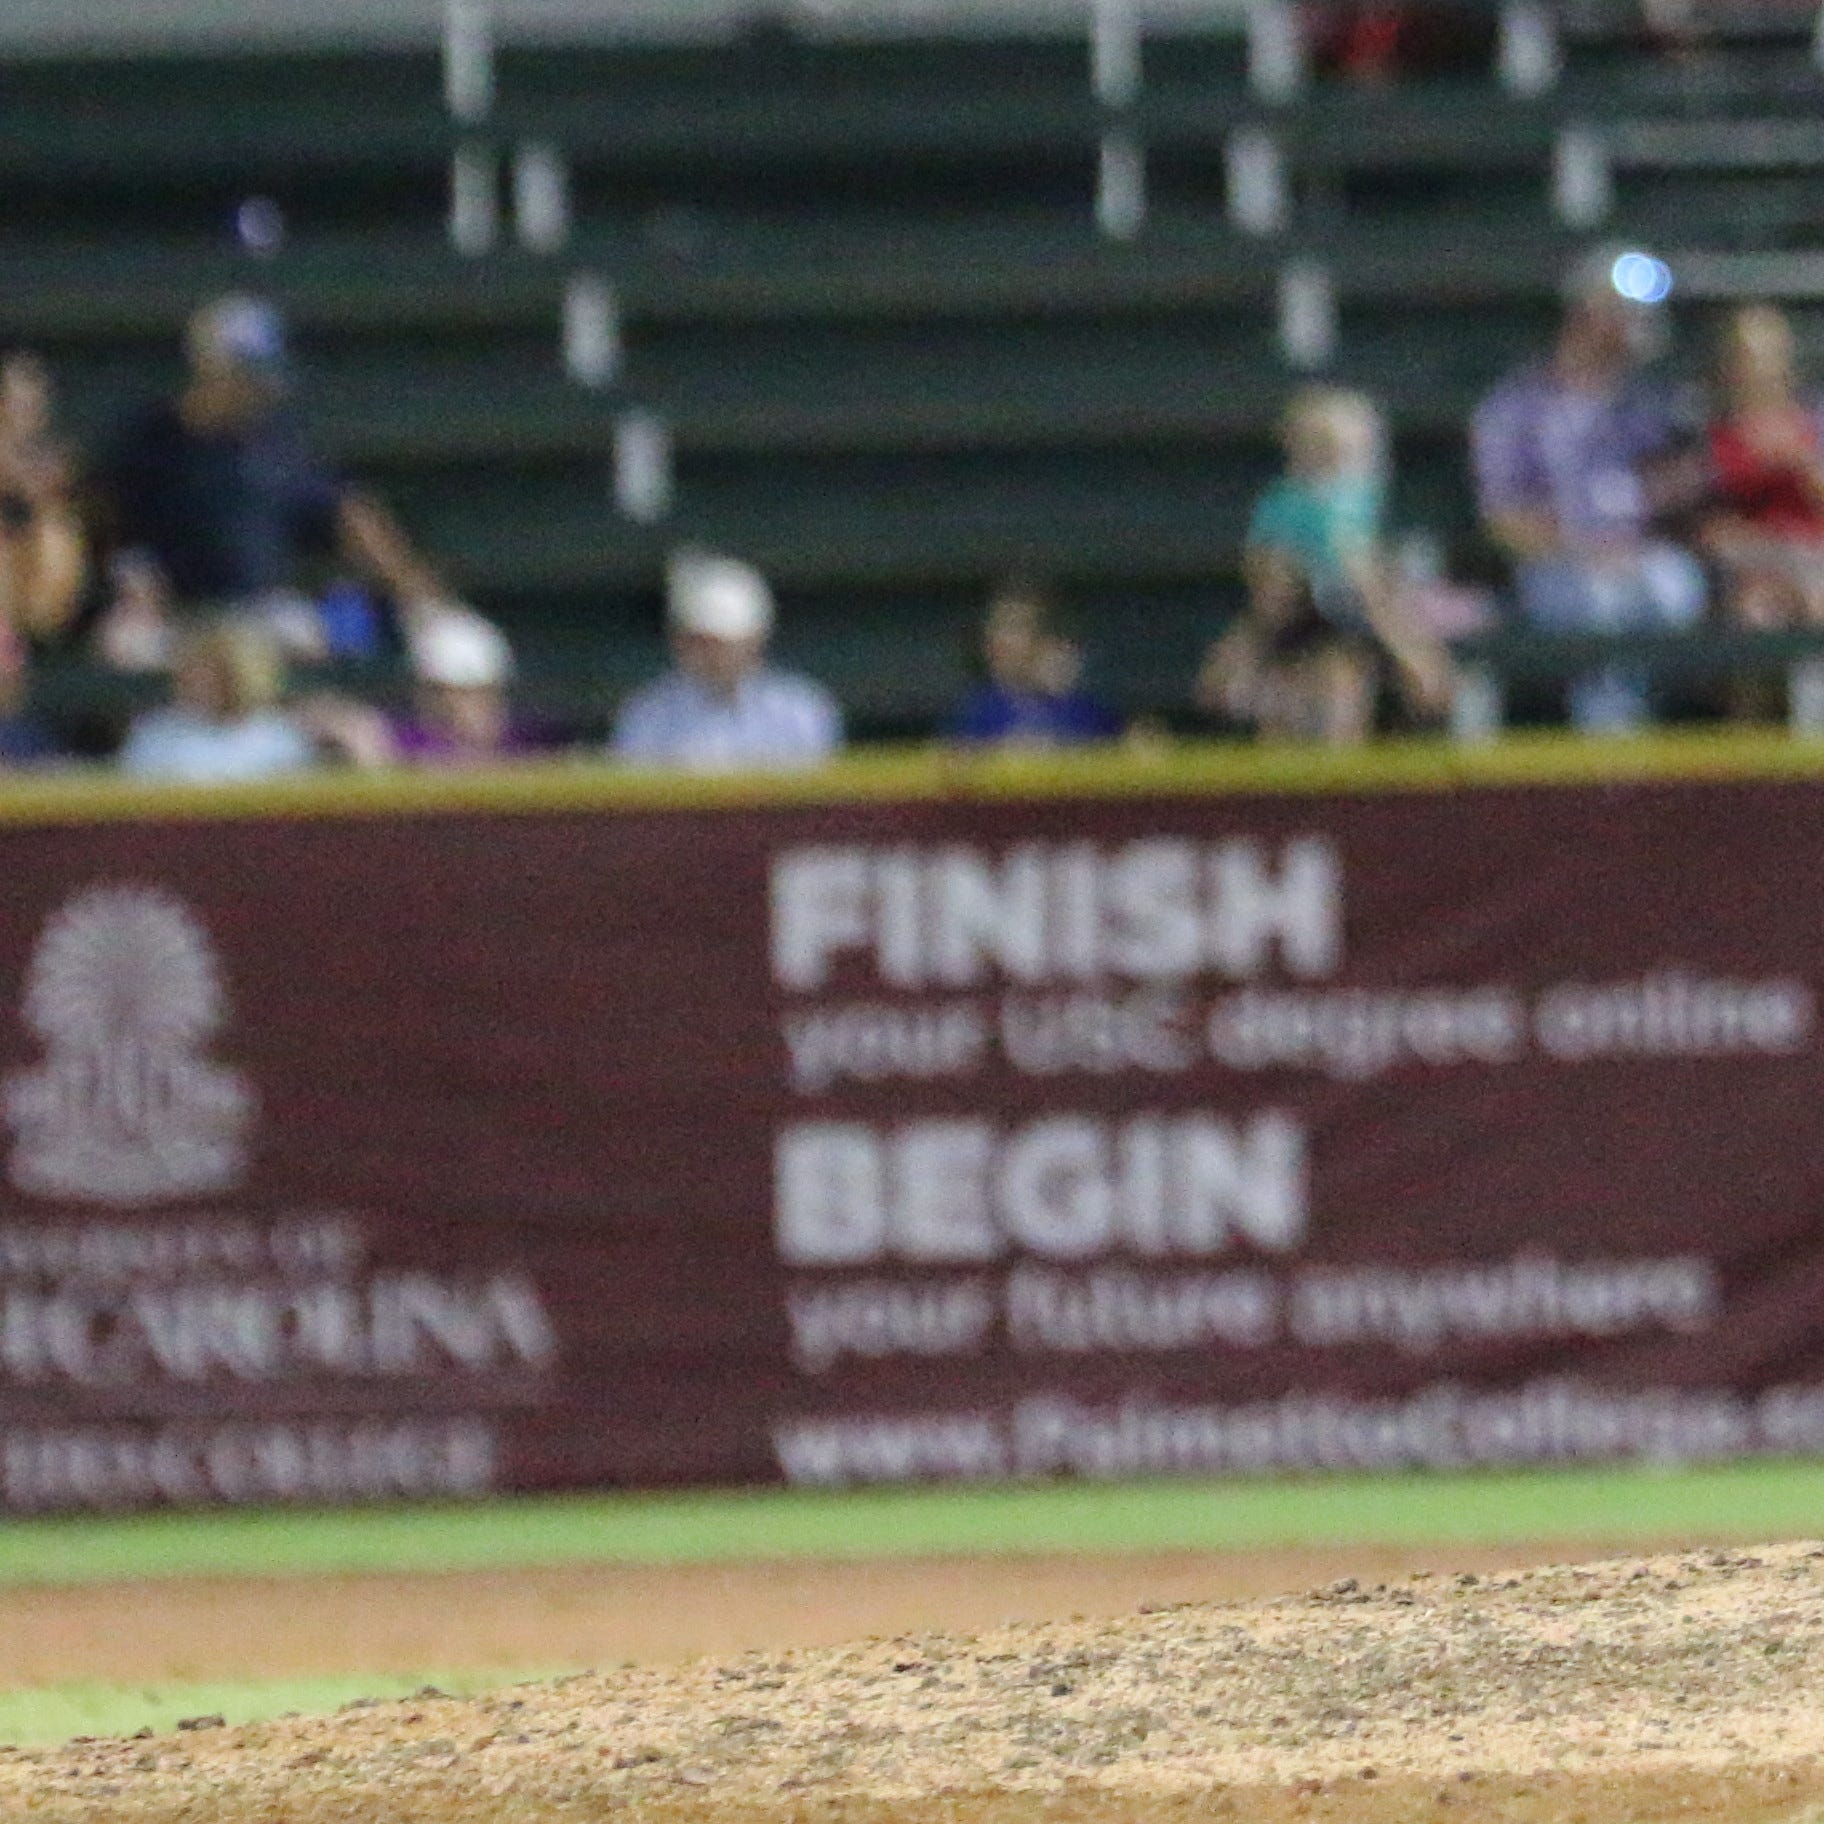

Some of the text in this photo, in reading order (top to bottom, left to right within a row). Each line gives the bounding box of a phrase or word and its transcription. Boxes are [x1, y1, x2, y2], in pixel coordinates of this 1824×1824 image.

[772, 838, 1342, 988] FINISH
[786, 966, 1812, 1094] your USC degree online
[775, 1114, 1308, 1262] BEGIN
[788, 1248, 1712, 1376] your future anywhere
